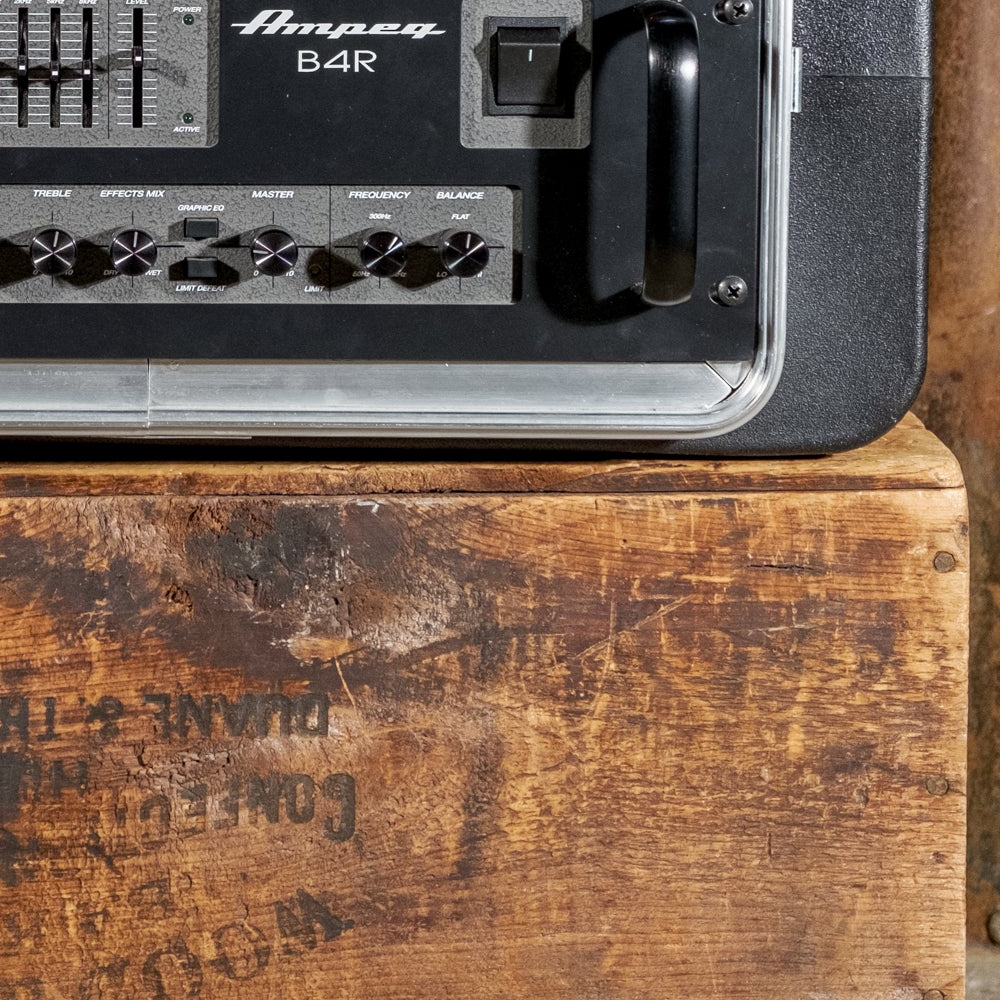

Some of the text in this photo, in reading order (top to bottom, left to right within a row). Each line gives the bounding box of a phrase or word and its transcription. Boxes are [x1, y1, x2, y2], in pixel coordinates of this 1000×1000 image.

[230, 9, 446, 39] Ampeg
[297, 49, 377, 73] B4R
[100, 190, 165, 198] EFFECTS MIX
[252, 190, 294, 199] MASTER
[349, 191, 411, 200] FREQUENCY
[436, 191, 484, 200] BALANCE
[177, 204, 224, 212] GRAPHIC EQ
[143, 693, 330, 741] DUANE
